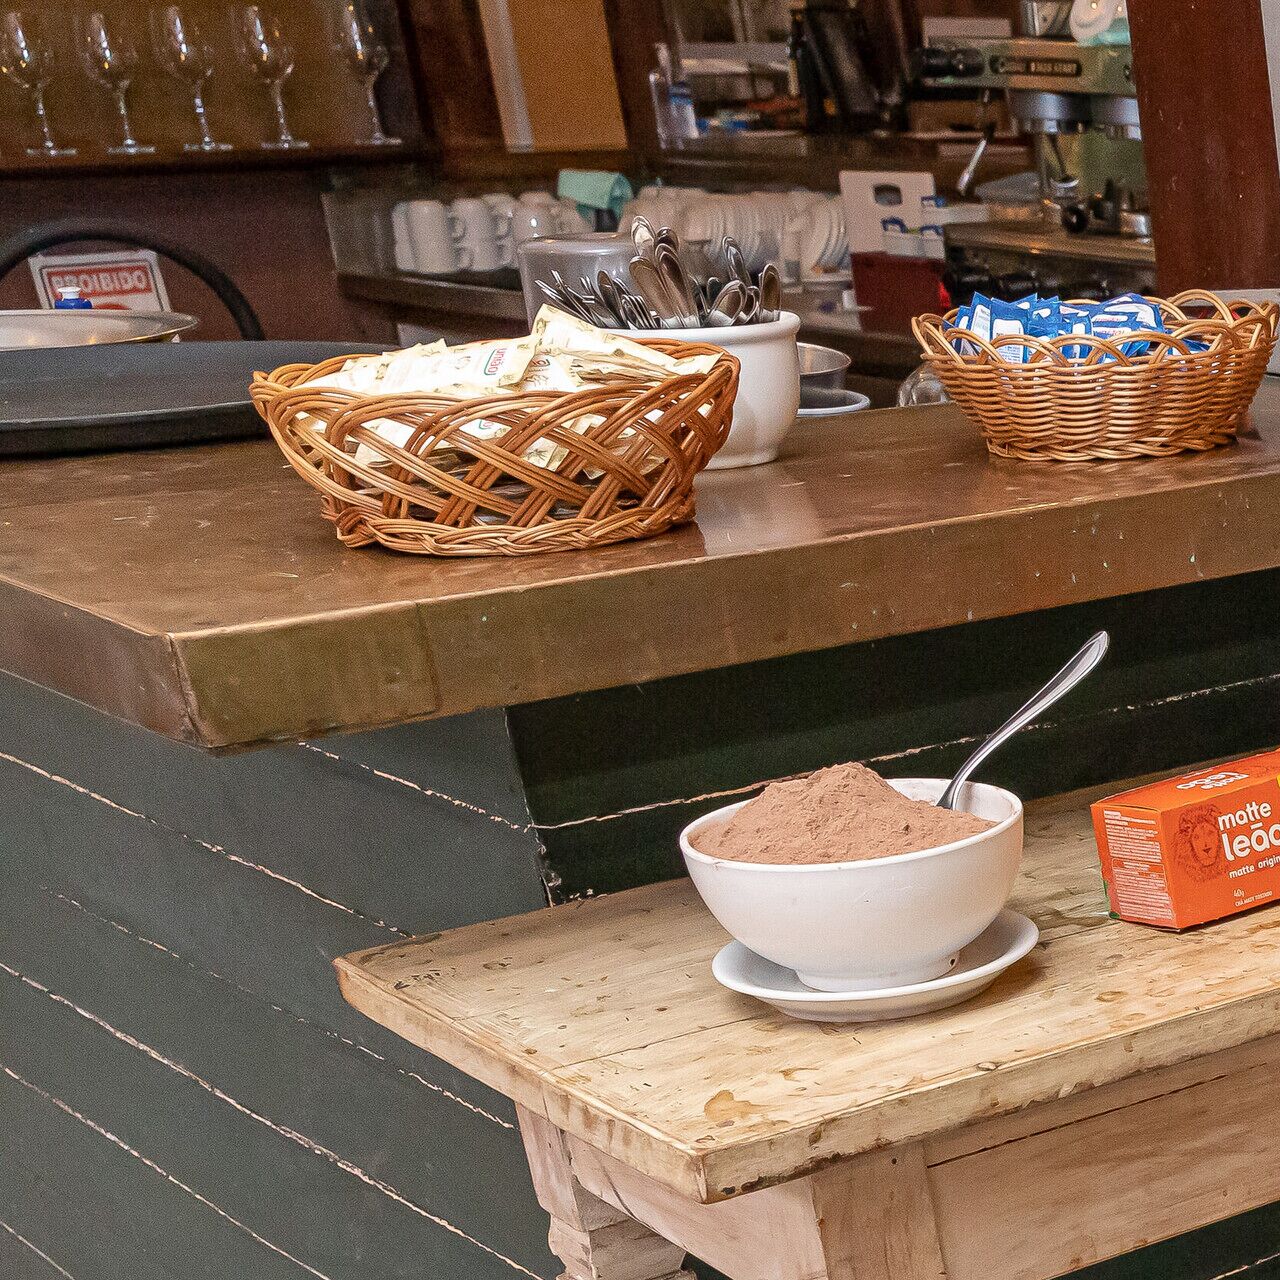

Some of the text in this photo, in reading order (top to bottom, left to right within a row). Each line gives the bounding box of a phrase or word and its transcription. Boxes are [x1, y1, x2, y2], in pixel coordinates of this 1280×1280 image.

[51, 270, 147, 294] PROIBIDO
[1217, 801, 1272, 832] matte
[1228, 864, 1256, 879] matte
